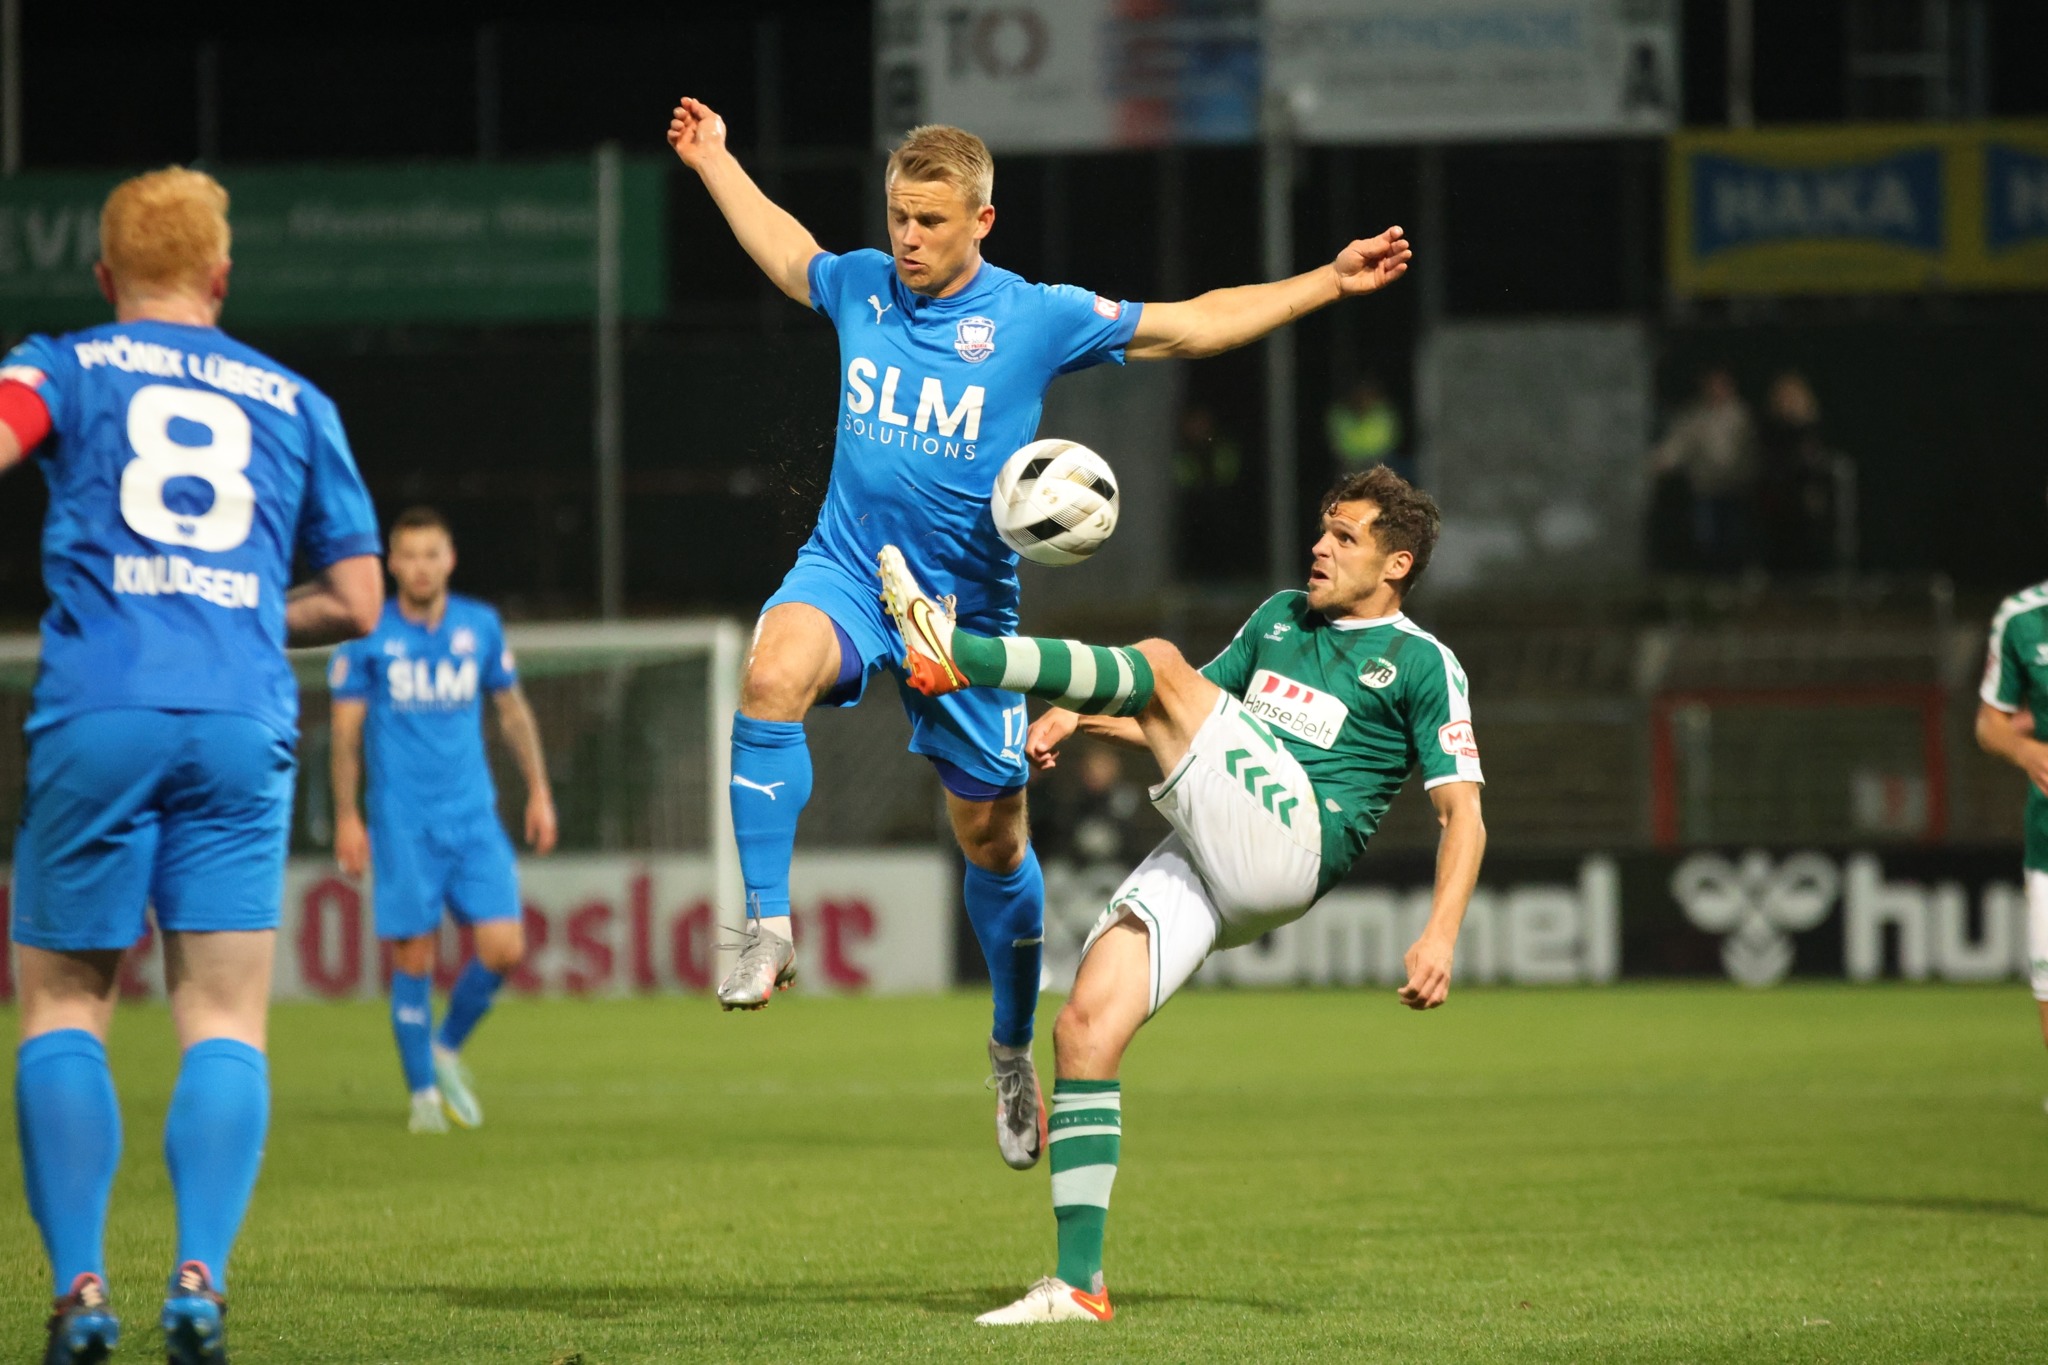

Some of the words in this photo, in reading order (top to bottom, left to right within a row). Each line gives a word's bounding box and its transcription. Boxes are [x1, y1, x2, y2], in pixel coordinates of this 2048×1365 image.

[74, 335, 185, 379] PHÖNIX
[187, 353, 302, 417] LÜBECK
[847, 357, 985, 442] SLM
[844, 413, 977, 461] SOLUTIONS
[119, 383, 255, 553] 8
[112, 553, 259, 610] KNUDSEN
[387, 657, 479, 702] SLM
[1002, 702, 1026, 748] 17
[1243, 693, 1333, 745] HanseBelt
[1845, 851, 2032, 982] hu
